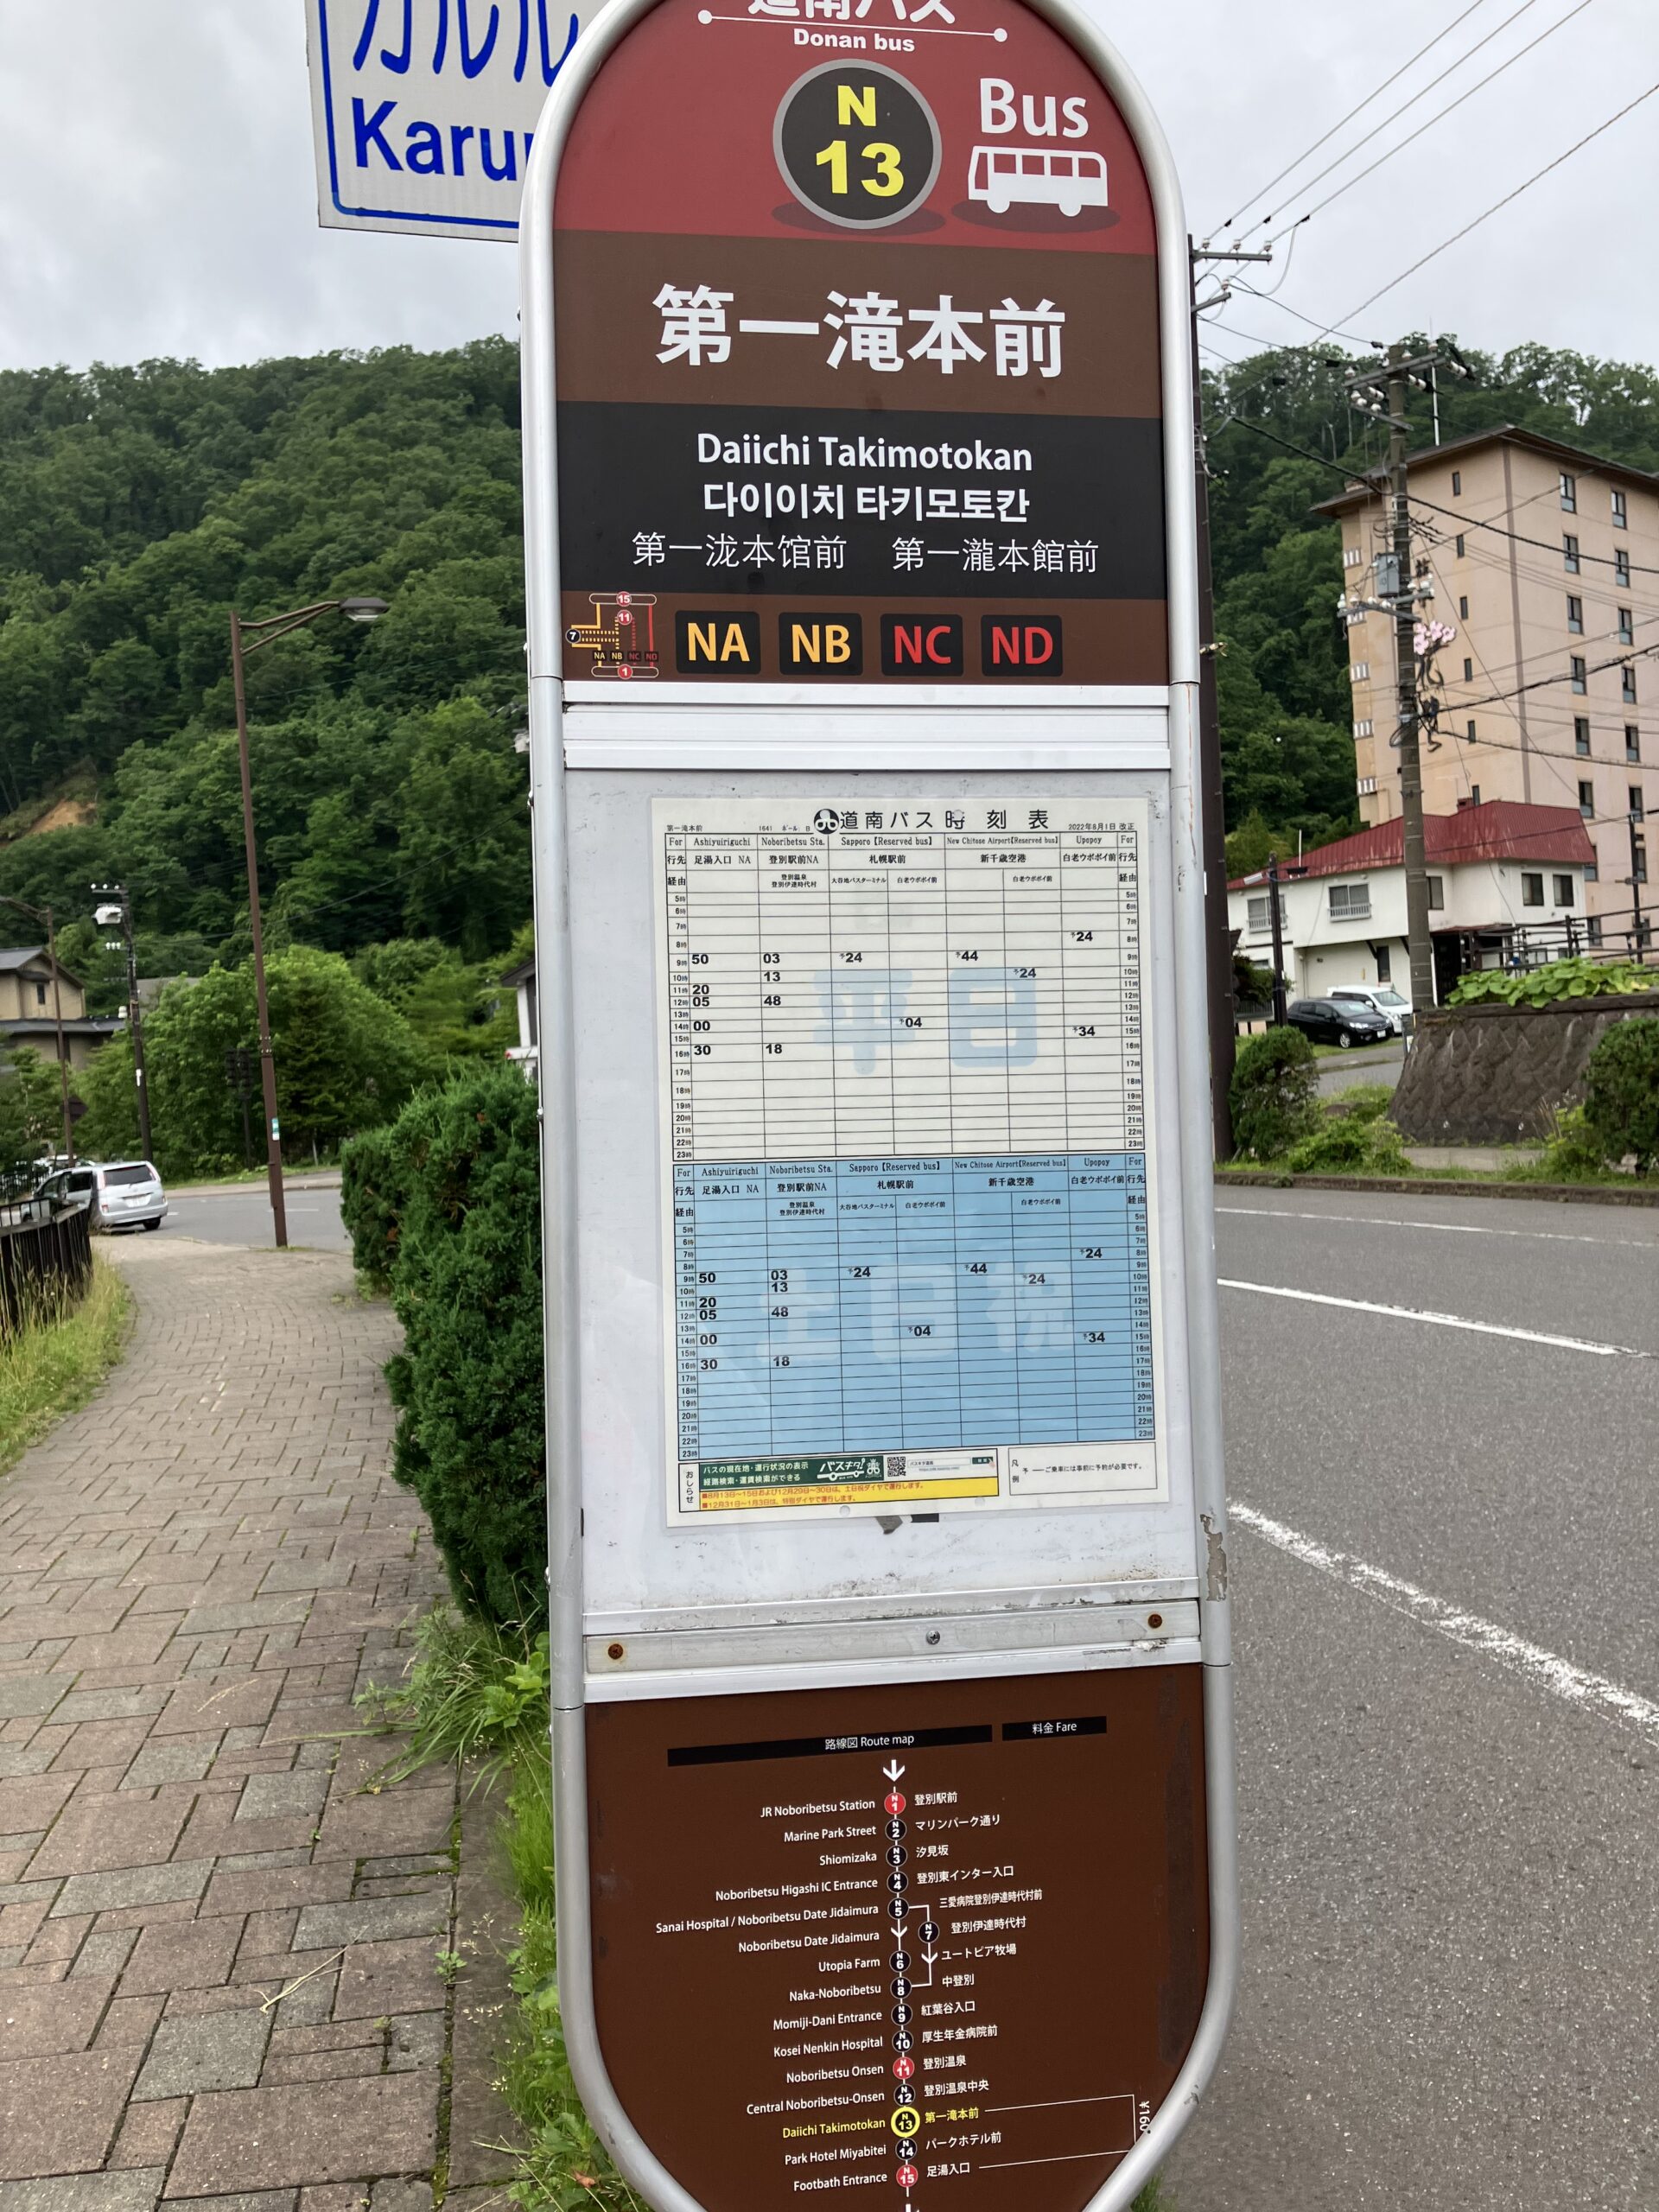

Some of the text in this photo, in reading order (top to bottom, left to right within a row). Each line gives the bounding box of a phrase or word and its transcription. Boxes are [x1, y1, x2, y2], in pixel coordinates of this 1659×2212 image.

[793, 29, 915, 52] Donan bus
[837, 85, 877, 127] N
[979, 78, 1089, 138] Bus
[816, 140, 905, 197] 13
[652, 283, 1066, 378] 第一滝本前
[697, 432, 1033, 473] Daiichi Takimotokan
[703, 480, 1030, 524] 다이이치 타키모토칸
[632, 531, 1099, 575] 第一泷本馆前 第一瀧本館前
[619, 613, 630, 622] 11
[687, 622, 1054, 666] NA NB NC ND
[669, 836, 683, 847] For
[694, 836, 751, 848] Ashiyuiriguchi
[761, 836, 807, 847] Noboribetsu
[810, 836, 825, 847] Sta.
[841, 836, 870, 847] Sapporo
[947, 836, 959, 845] New
[1076, 836, 1102, 845] Upopoy
[1121, 836, 1135, 844] For
[667, 855, 686, 865] 行先
[739, 855, 751, 865] NA
[869, 855, 906, 864] 札幌駅前
[980, 853, 1026, 863] 新千歳空港
[1118, 852, 1137, 862] 行先
[667, 873, 1137, 887] 経由 経由
[1076, 931, 1093, 942] 24
[691, 950, 978, 964] 50 03 24 44
[764, 968, 1037, 982] 13 24
[692, 984, 709, 995] 20
[692, 995, 781, 1007] 05 48
[693, 1017, 922, 1031] 00 04
[1078, 1026, 1096, 1037] 34
[694, 1044, 782, 1056] 30 18
[698, 1272, 716, 1283] 50
[771, 1270, 788, 1281] 03
[772, 1282, 788, 1293] 13
[699, 1297, 716, 1307] 20
[699, 1306, 789, 1320] 05 48
[700, 1334, 717, 1344] 00
[701, 1356, 790, 1370] 30 18
[1032, 1721, 1077, 1735] 料金 Fare
[825, 1734, 914, 1751] 路線図 Route map
[914, 1791, 957, 1806] 登別駅前
[760, 1800, 875, 1818] JR Noboribetsu Station
[915, 1814, 1001, 1832] マリンパーク通り
[784, 1825, 876, 1842] Marine Park Street
[819, 1852, 877, 1866] Shiomizaka
[916, 1844, 949, 1859] 汐見坂
[917, 1866, 1014, 1885] 登別東インター入口
[715, 1878, 878, 1901] Noboribetsu Higashi IC Entrance
[656, 1904, 879, 1934] Sanai Hospital Noboribetsu Date Jidaimura
[738, 1930, 880, 1953] Noboribetsu Date Jidaimura
[941, 1943, 1017, 1961] ユートピア牧場
[818, 1957, 880, 1974] Utopia Farm
[942, 1974, 975, 1987] 中登別
[789, 1985, 881, 2002] Naka-Noboribetsu
[921, 2000, 976, 2017] 紅葉谷入口
[773, 2011, 882, 2031] Momiji-Dani Entrance
[922, 2024, 998, 2044] 厚生年金病院前
[773, 2036, 883, 2057] Kosei Nenkin Hospital
[923, 2055, 967, 2070] 登別温泉
[786, 2064, 884, 2083] Noboribetsu Onsen
[924, 2079, 989, 2097] 登別温泉中央
[747, 2092, 885, 2115] Central Noboribetsu-Onsen
[925, 2107, 980, 2123] 第一滝本前
[782, 2119, 886, 2139] Daiichi Takimotokan
[925, 2131, 1002, 2150] パークホテル前
[785, 2145, 887, 2165] Park Hotel Miyabitei
[926, 2163, 970, 2177] 足湯入口
[793, 2172, 887, 2191] Footbath Entrance
